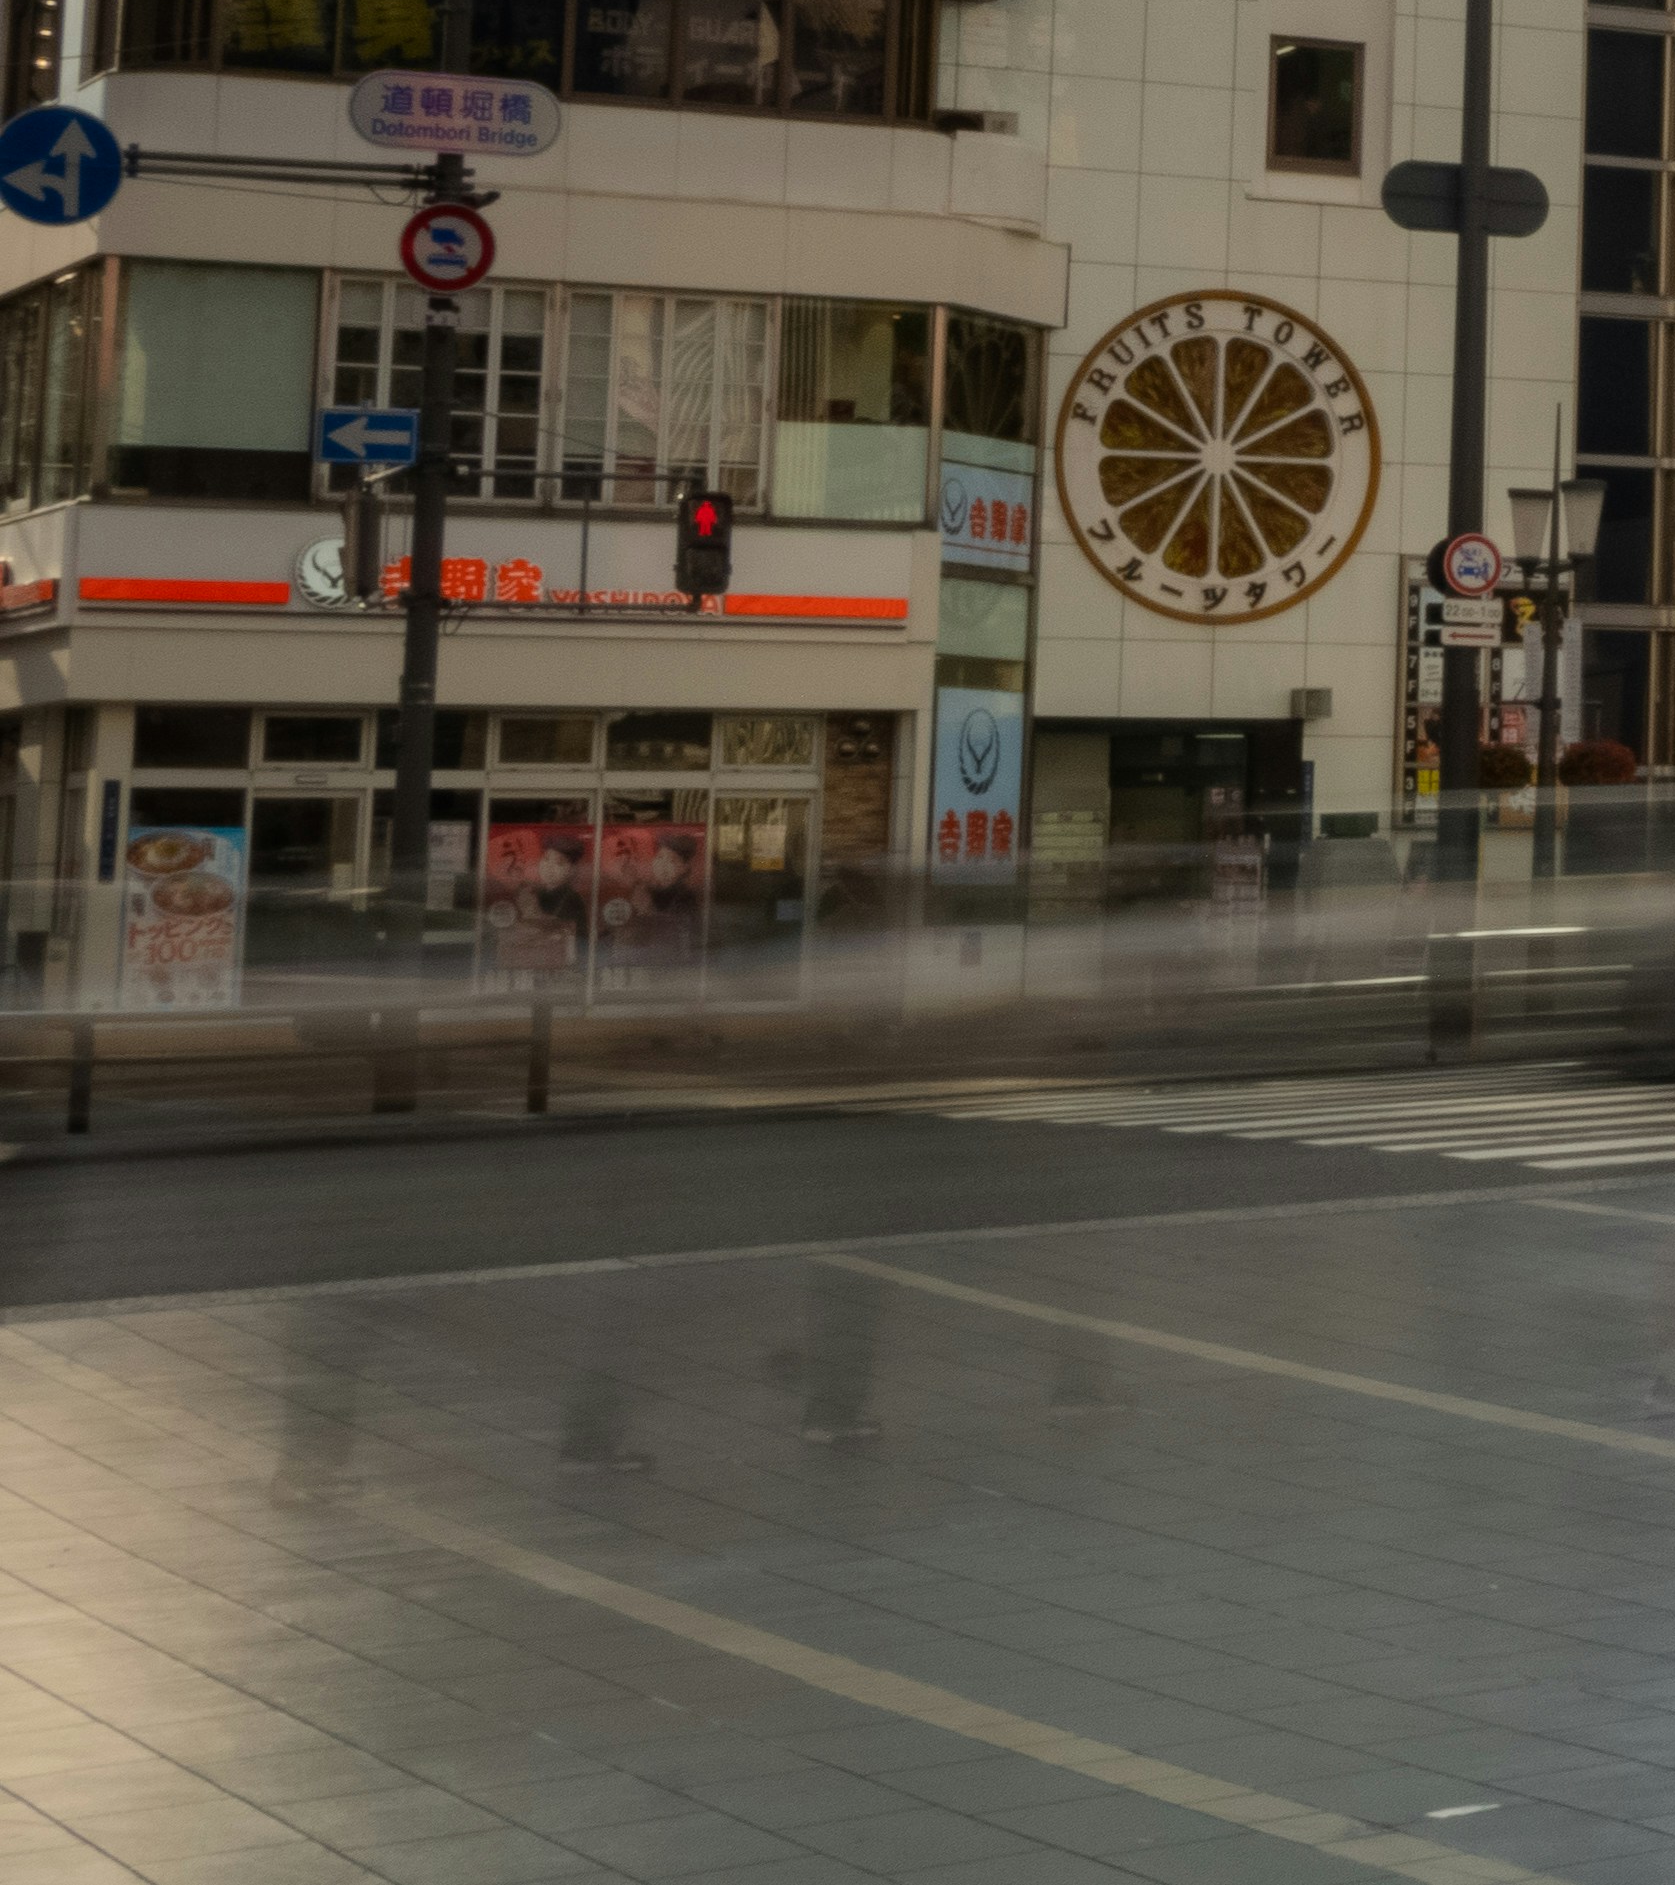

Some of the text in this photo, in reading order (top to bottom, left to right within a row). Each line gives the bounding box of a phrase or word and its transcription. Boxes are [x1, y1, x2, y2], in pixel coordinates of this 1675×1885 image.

[381, 83, 533, 125] 道頓堀橋
[477, 127, 537, 150] Bridge
[1072, 303, 1365, 436] FRUITS TOWER
[1086, 518, 1347, 612] フルーツタワー
